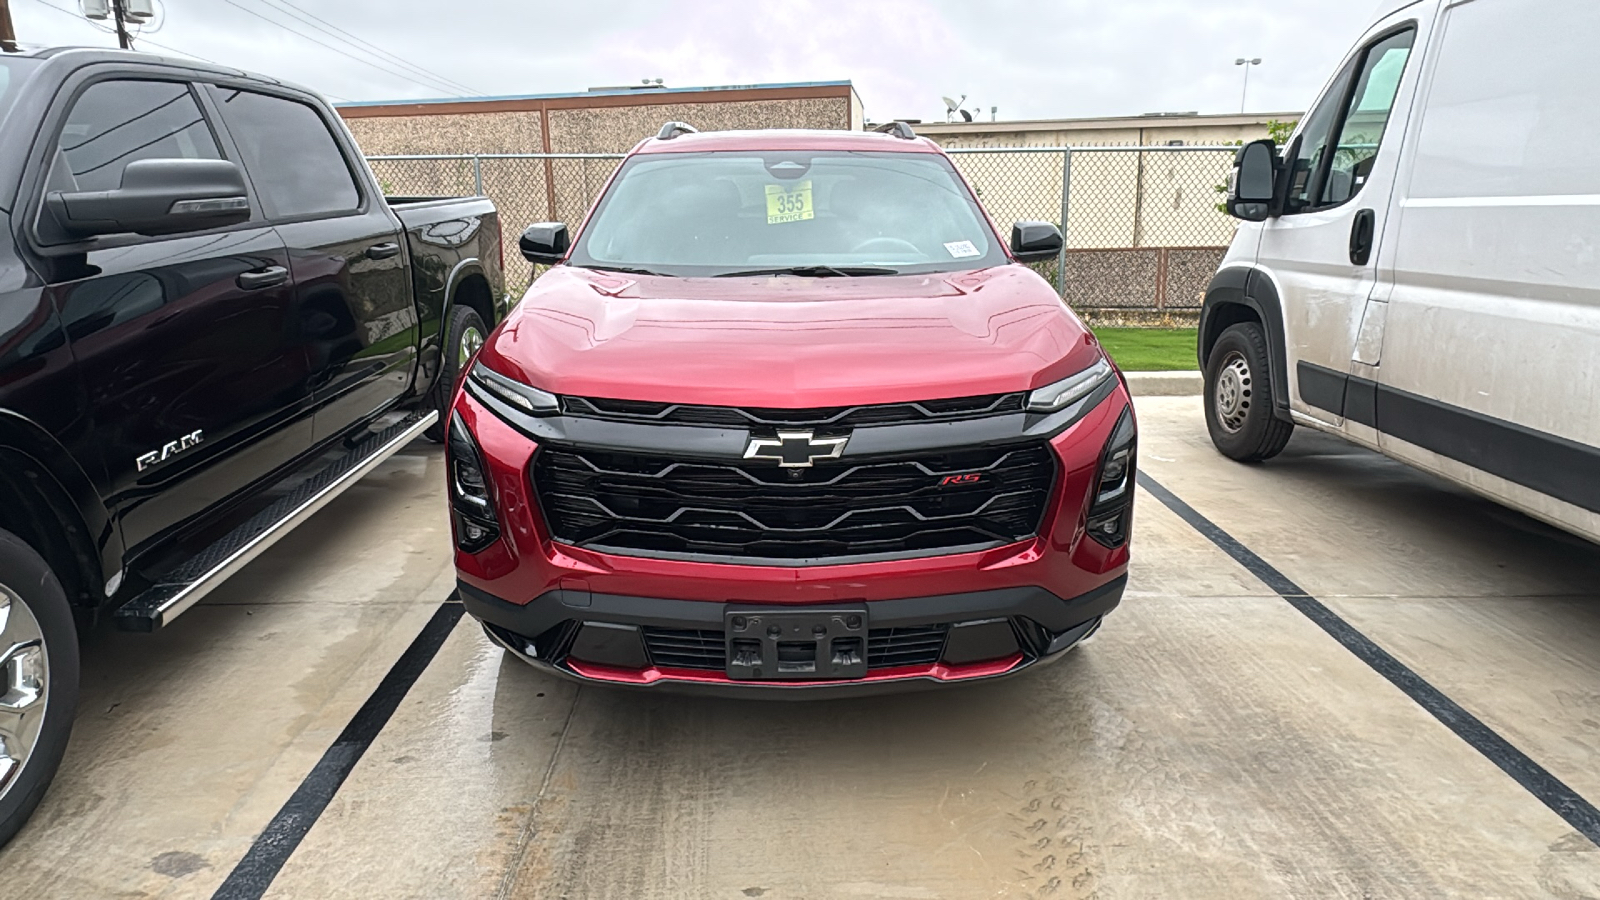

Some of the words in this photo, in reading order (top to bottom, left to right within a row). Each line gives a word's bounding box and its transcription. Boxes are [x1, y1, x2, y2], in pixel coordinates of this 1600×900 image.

[777, 193, 804, 214] 355
[769, 214, 803, 223] SERVICE
[136, 429, 204, 472] RAM
[941, 472, 982, 486] RS
